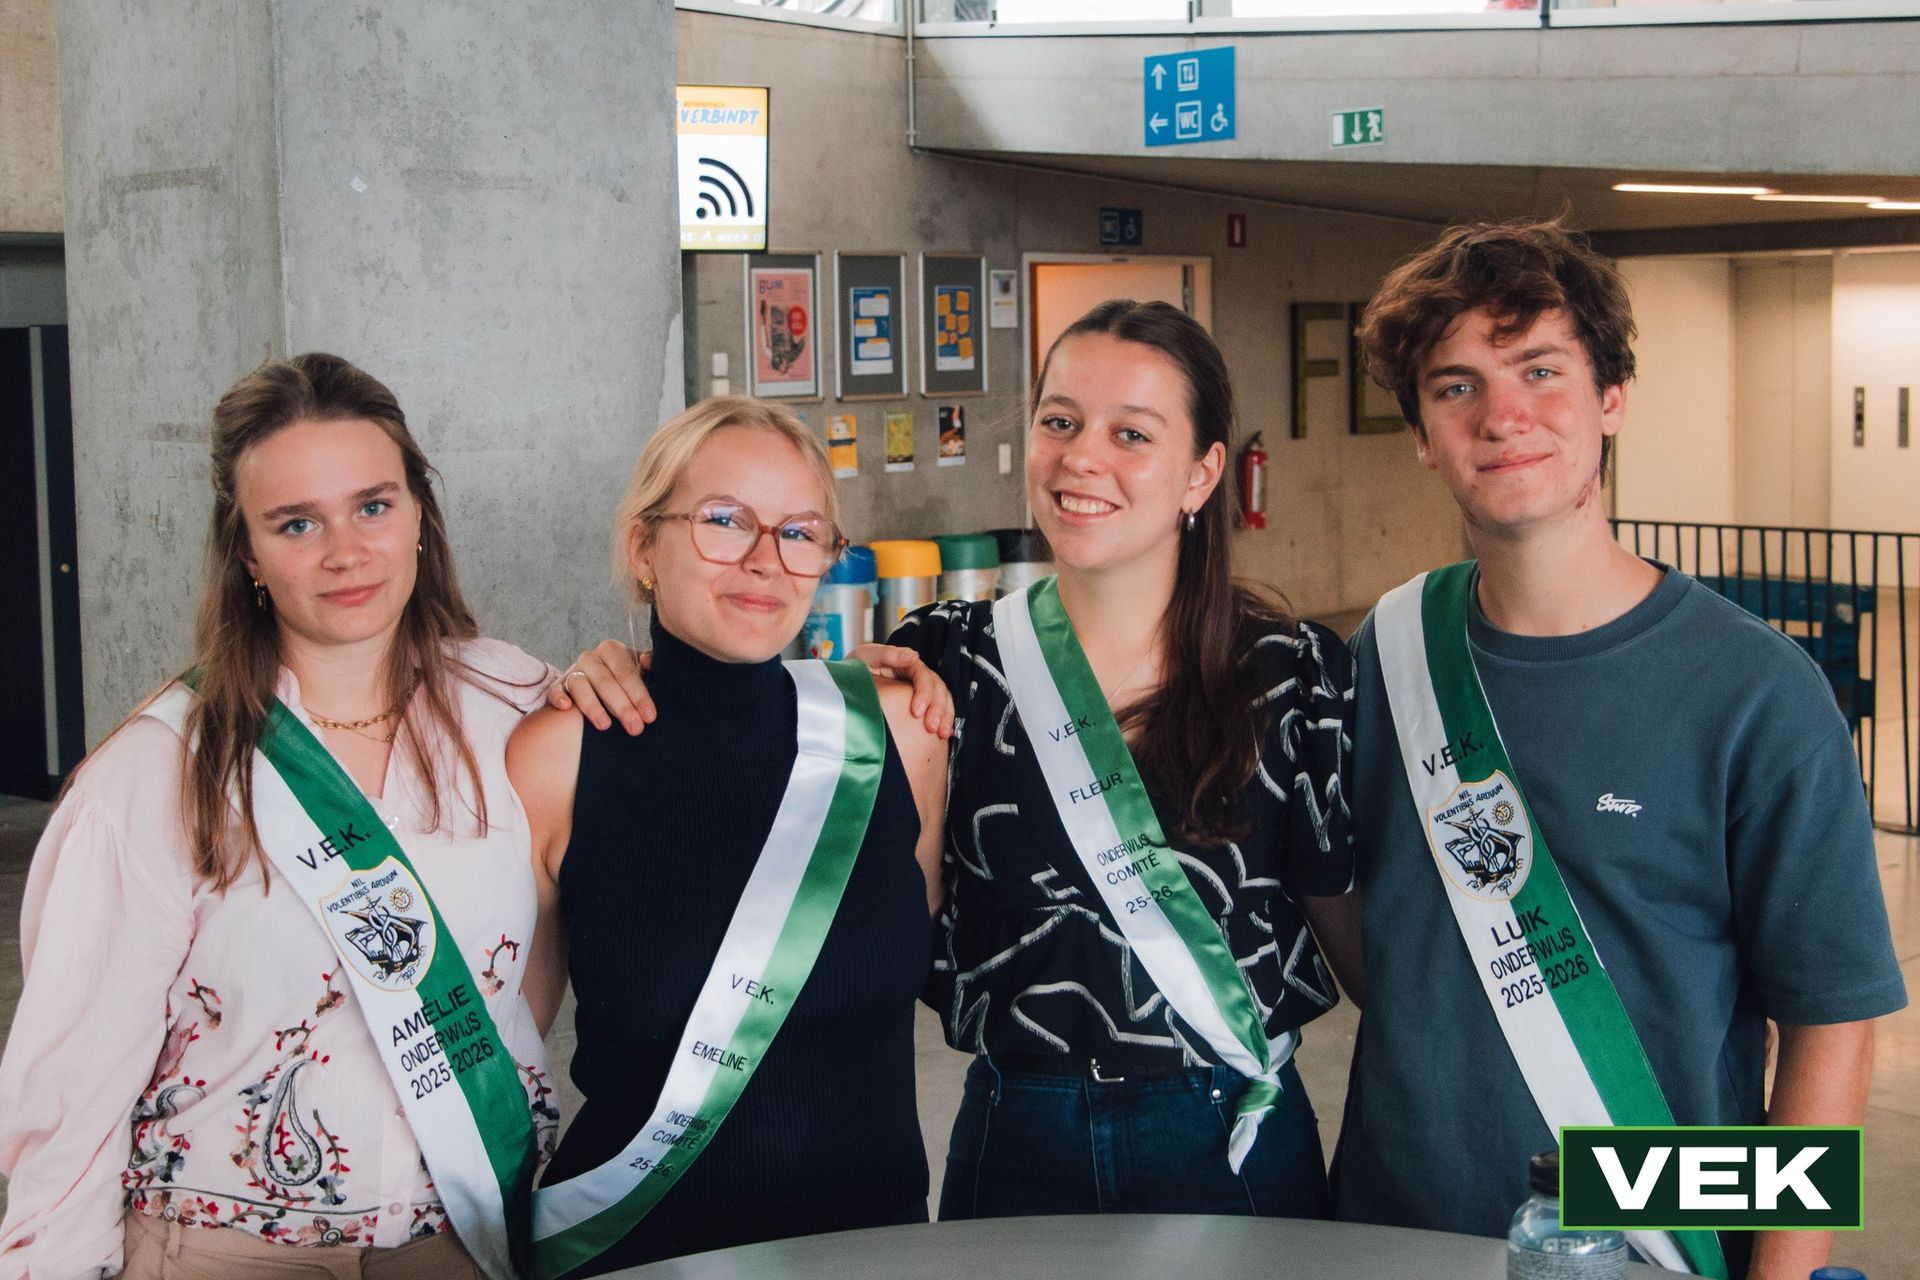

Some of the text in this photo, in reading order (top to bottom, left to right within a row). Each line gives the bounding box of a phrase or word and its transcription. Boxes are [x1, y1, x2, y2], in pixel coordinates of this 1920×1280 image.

[680, 109, 760, 126] VERBINDT
[1179, 114, 1198, 129] WC
[1049, 715, 1097, 742] V.E.K.
[1422, 731, 1484, 777] V.E.K.
[1069, 772, 1124, 804] FLEUR
[1458, 789, 1472, 801] NIL
[1433, 799, 1475, 823] VOLENTIBUS
[296, 823, 371, 870] V.E.K.
[1096, 832, 1150, 867] ONDERWIJS
[351, 878, 366, 889] NIL
[1106, 849, 1161, 886] COMITÉ
[326, 886, 370, 913] VOLENTIBUS
[1125, 885, 1173, 915] 25-26
[1490, 905, 1551, 947] LUIK
[1490, 927, 1576, 980] ONDERWIJS
[1501, 954, 1589, 1009] 2025-2026
[392, 983, 472, 1047] AMÉLIE
[400, 1011, 482, 1072] ONDERWIJS
[692, 1041, 748, 1071] EMELINE
[411, 1036, 494, 1100] 2025-2026
